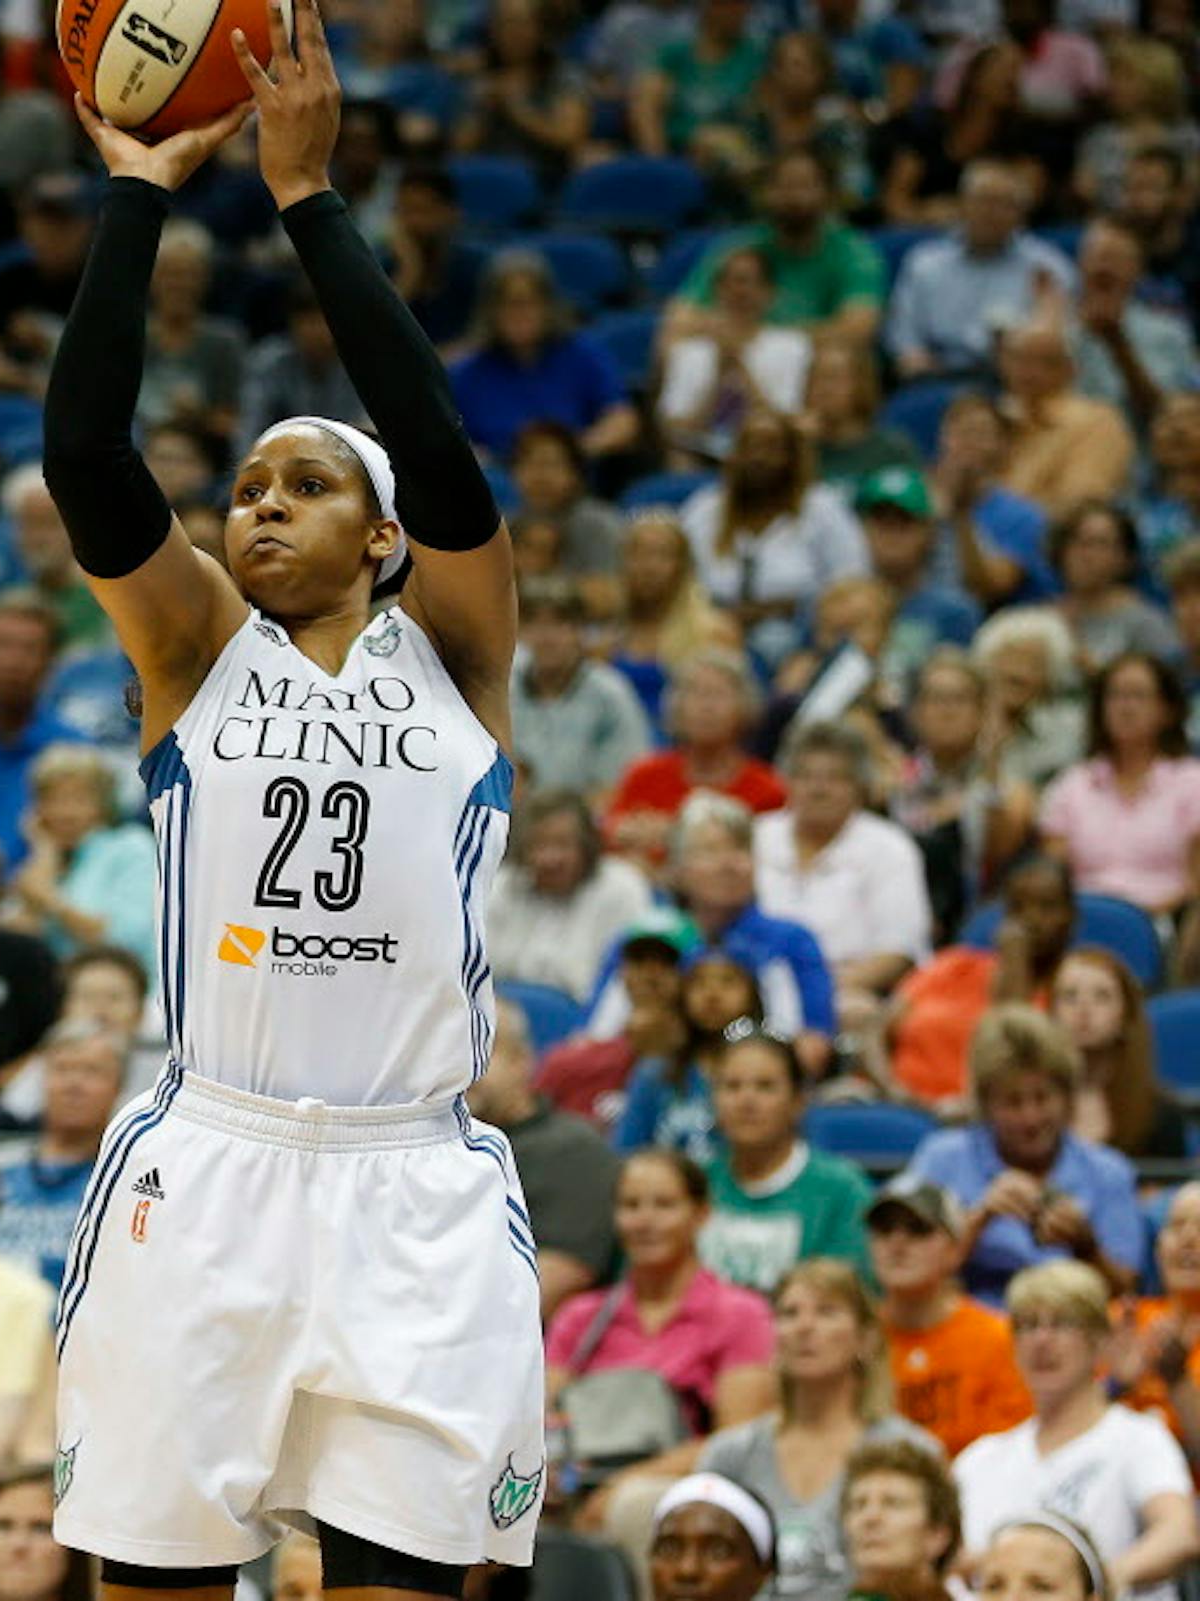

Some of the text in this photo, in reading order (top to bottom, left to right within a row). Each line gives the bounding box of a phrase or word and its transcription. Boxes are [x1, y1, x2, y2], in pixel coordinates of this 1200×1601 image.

[235, 667, 415, 713] MAYO
[213, 716, 439, 772] CLINIC
[253, 775, 371, 913] 23
[272, 926, 399, 963] boost
[271, 961, 339, 976] mobile
